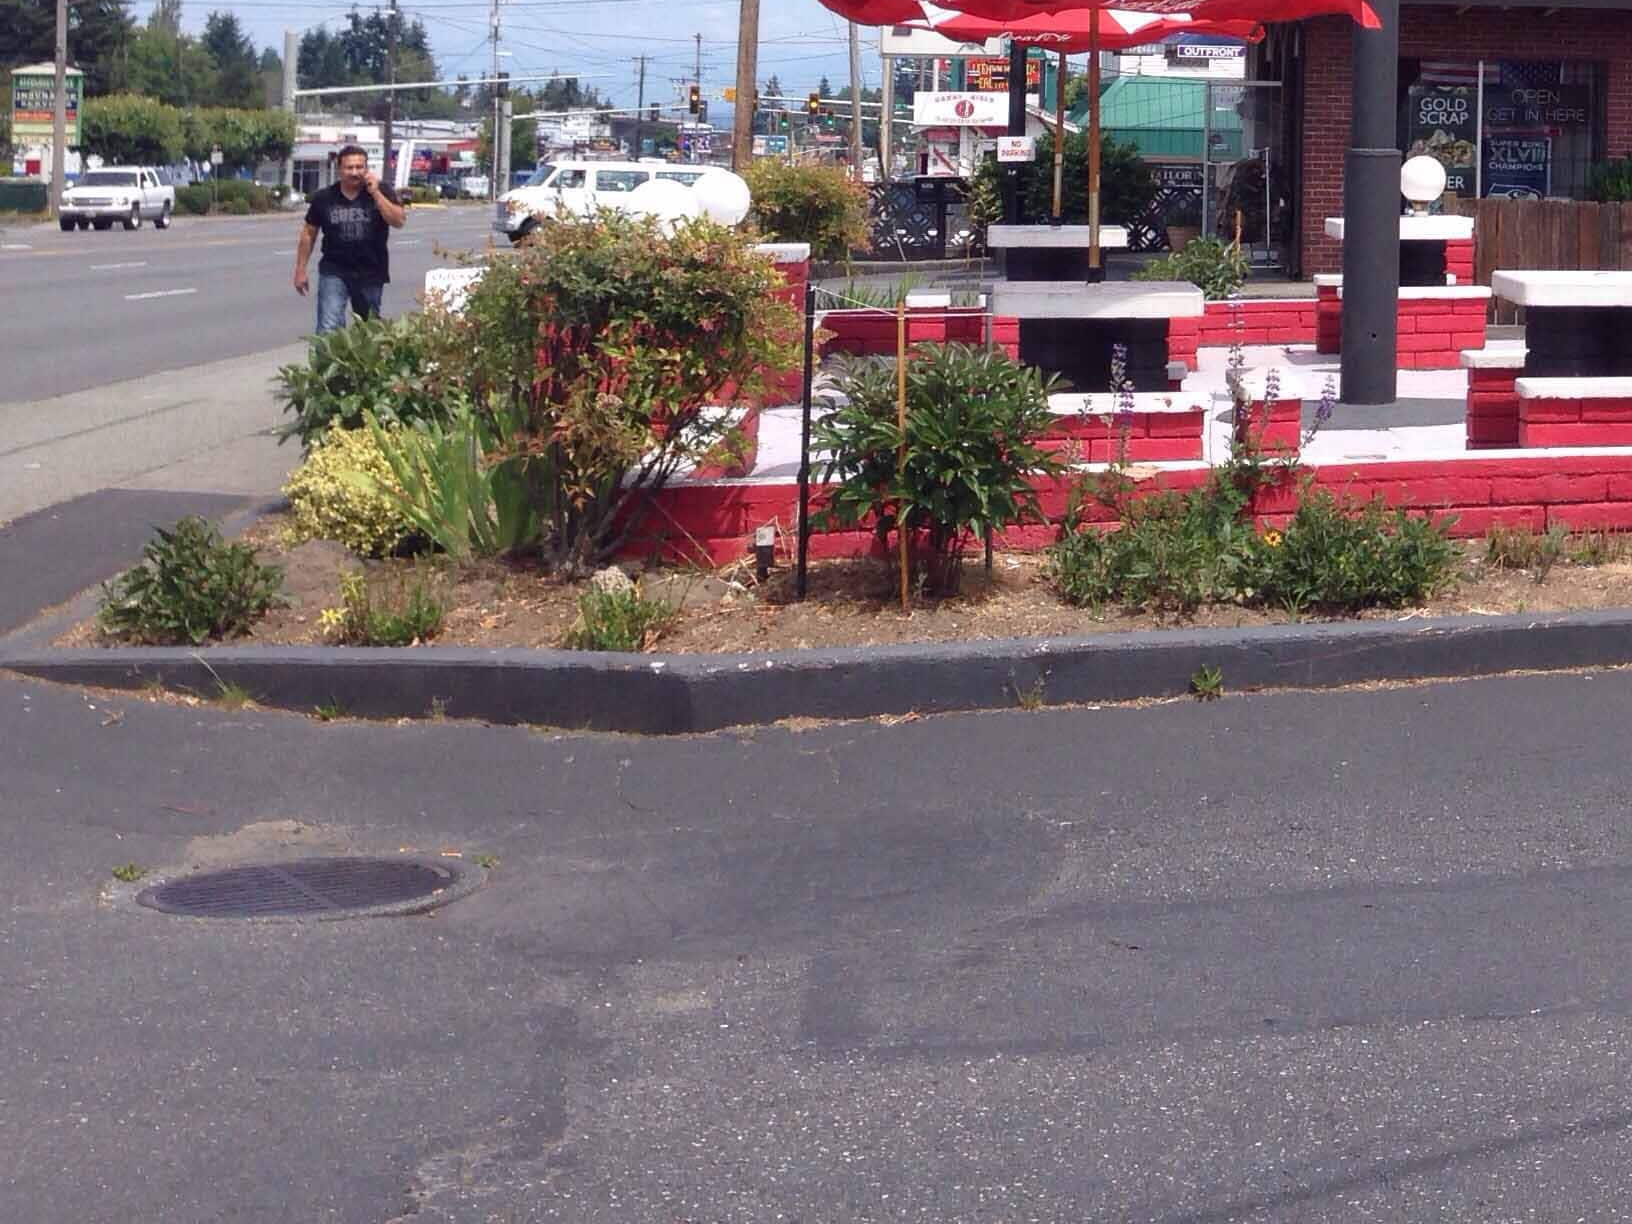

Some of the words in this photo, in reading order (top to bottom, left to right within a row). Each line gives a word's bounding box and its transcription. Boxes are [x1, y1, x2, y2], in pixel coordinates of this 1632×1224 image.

[1183, 45, 1241, 57] OUTFRONT
[1511, 89, 1560, 105] OPEN
[1420, 98, 1467, 111] GOLD
[1419, 111, 1469, 125] SCRAP
[1487, 107, 1517, 121] GET
[1524, 108, 1540, 121] IN
[1544, 108, 1585, 122] HERE
[1011, 139, 1023, 149] NO
